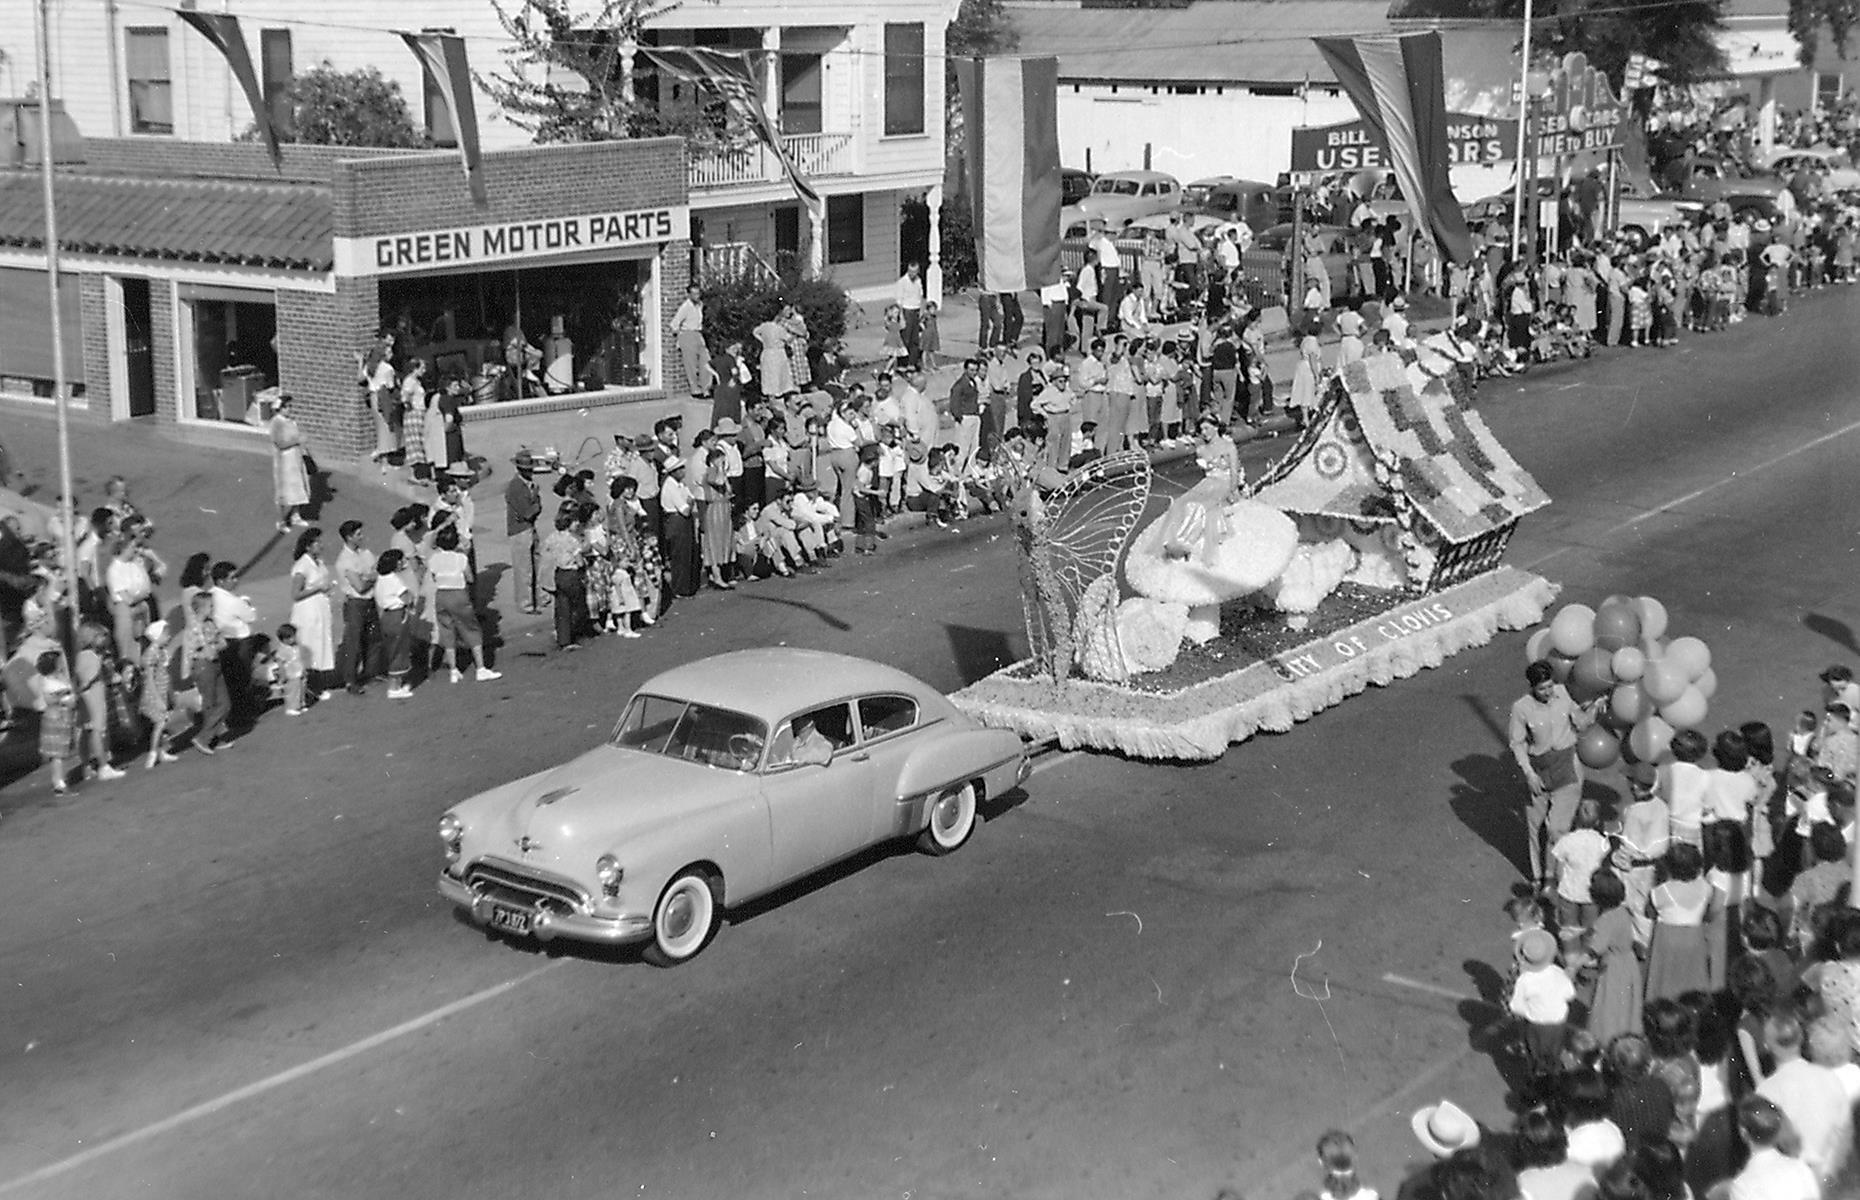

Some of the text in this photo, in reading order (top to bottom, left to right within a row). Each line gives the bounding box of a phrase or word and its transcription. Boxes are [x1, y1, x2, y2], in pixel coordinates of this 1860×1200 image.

[1585, 109, 1620, 127] ARS
[1328, 123, 1498, 146] BILL NSON
[1566, 136, 1581, 150] TO
[1584, 128, 1616, 148] BUY
[1316, 140, 1503, 169] USE ARS
[376, 210, 671, 267] GREEN MOTOR PARTS
[1271, 602, 1453, 683] CITY OF CLOVIS
